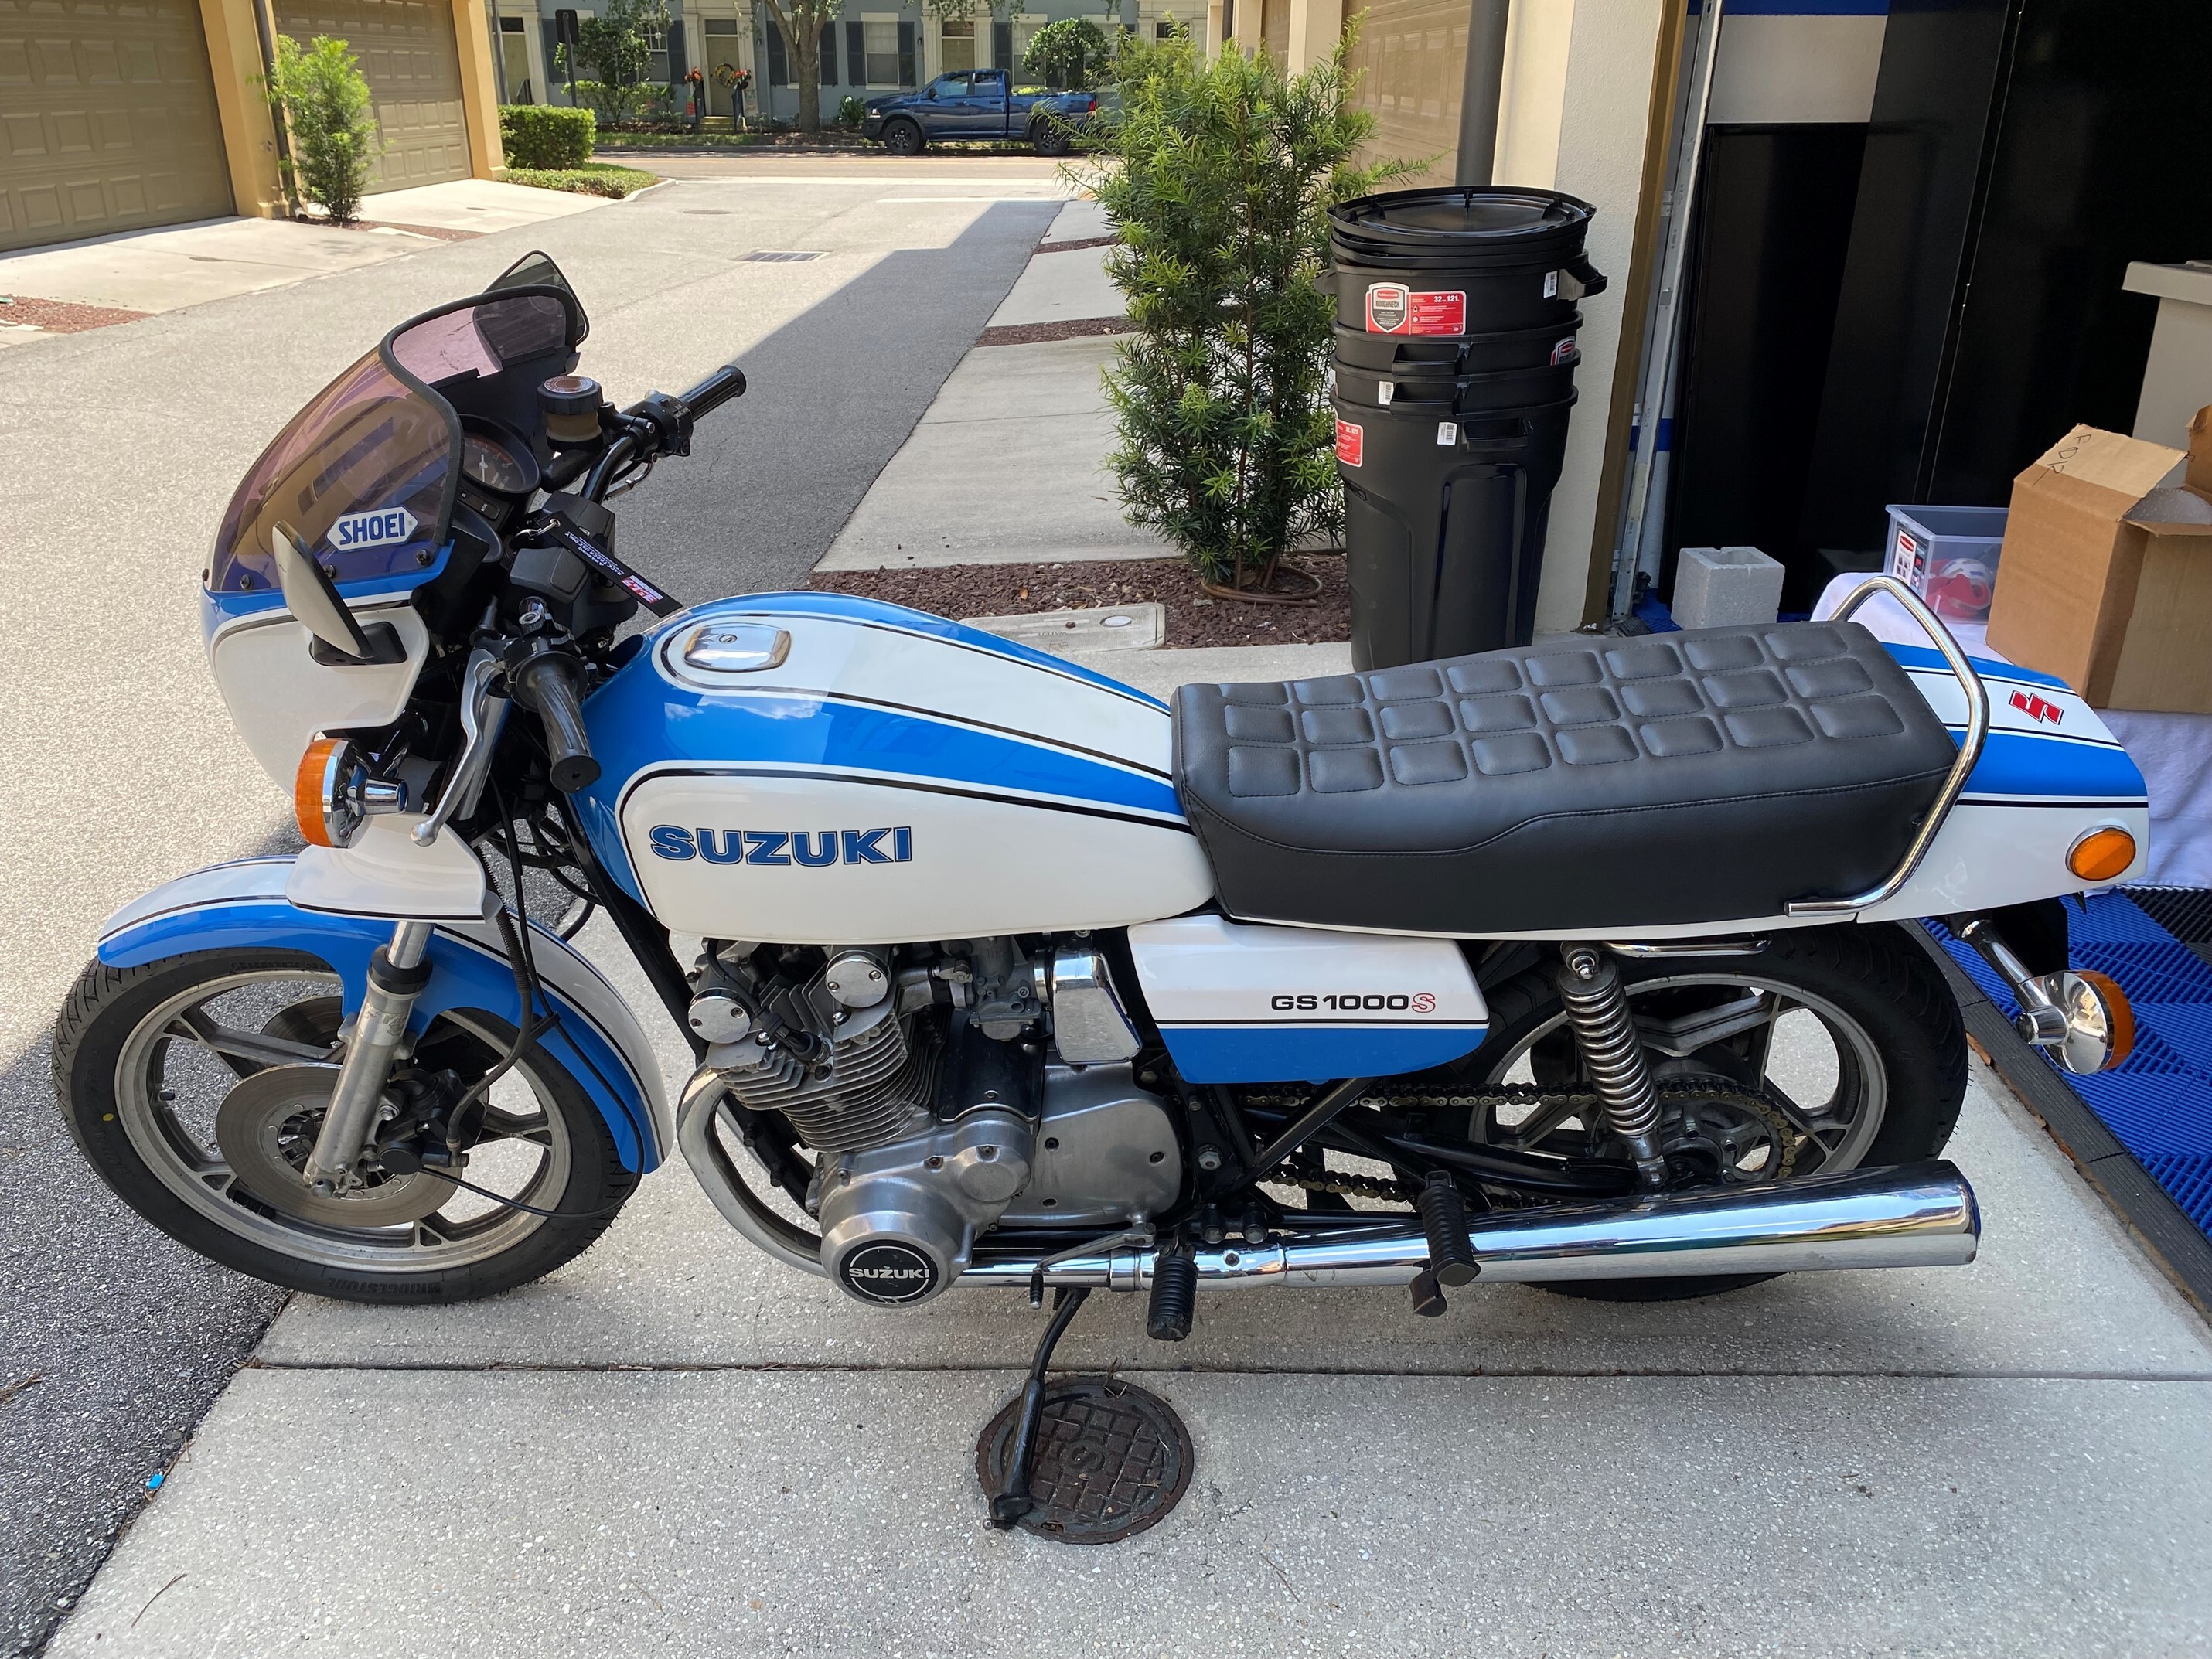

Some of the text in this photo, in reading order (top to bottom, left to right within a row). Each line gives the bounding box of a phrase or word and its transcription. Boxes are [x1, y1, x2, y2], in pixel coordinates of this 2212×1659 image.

[339, 513, 405, 546] SHOEI
[649, 824, 912, 867] SUZUKI
[849, 1268, 930, 1279] SUZUKI
